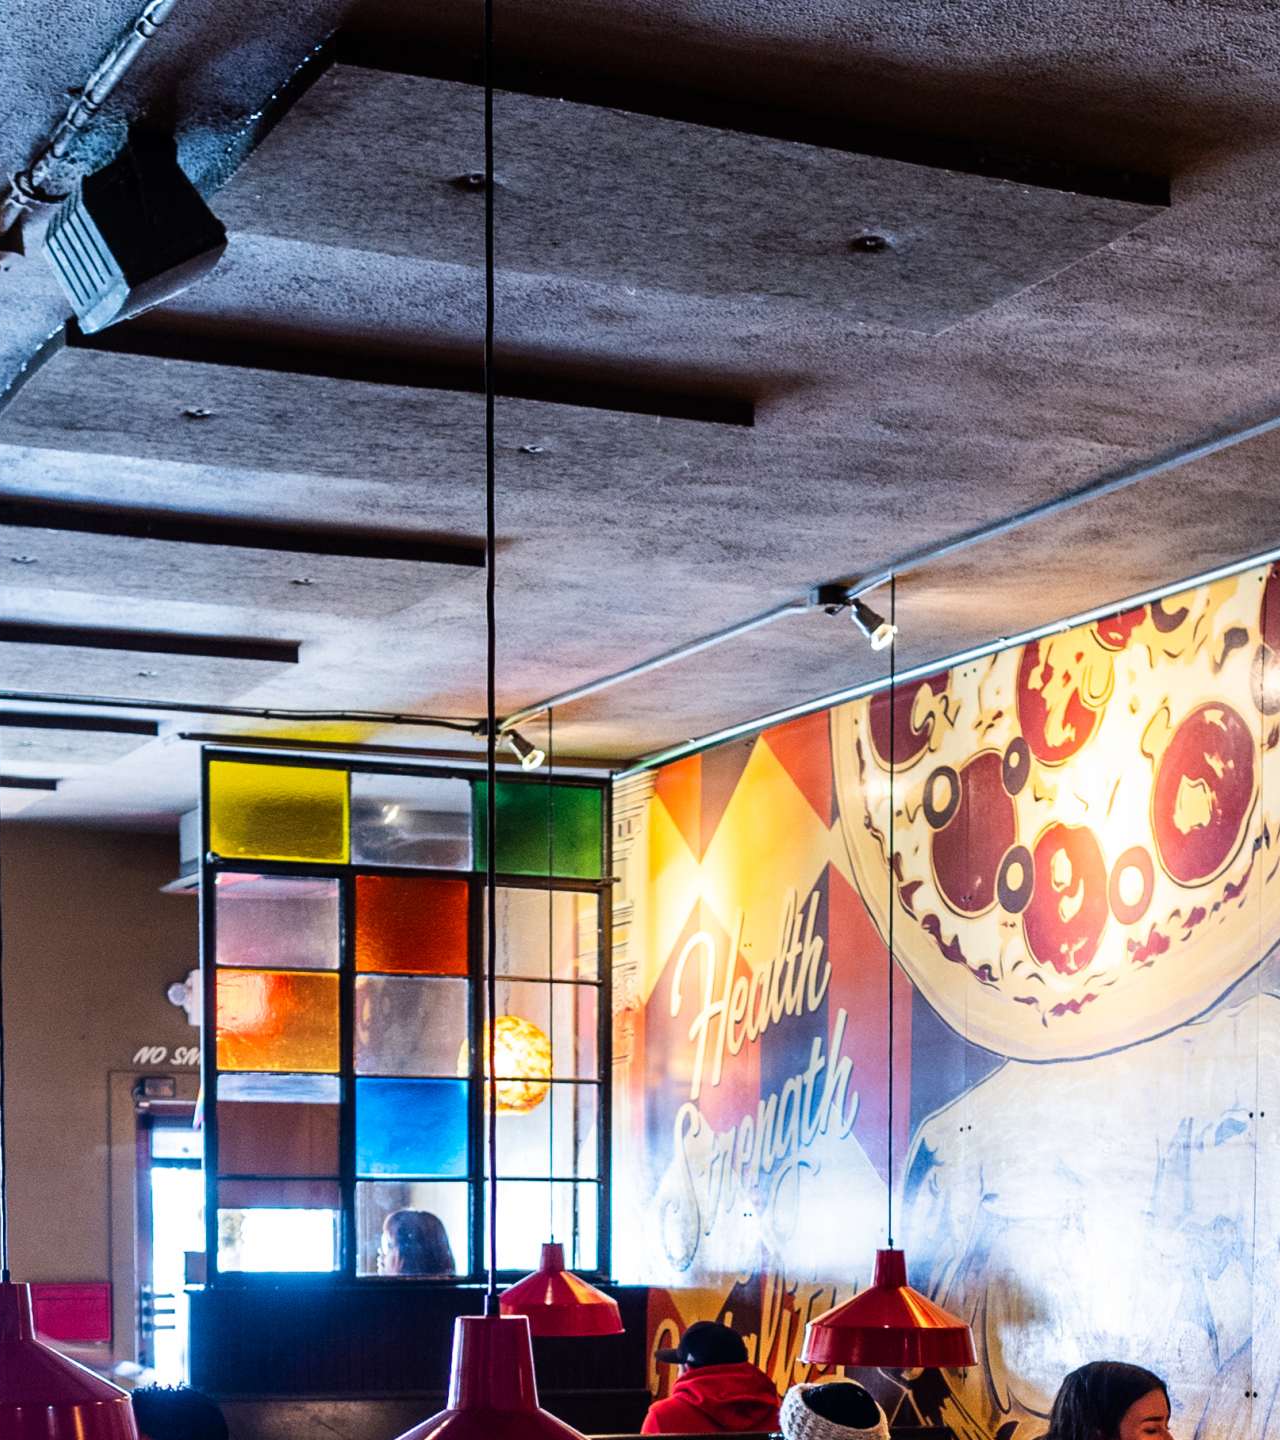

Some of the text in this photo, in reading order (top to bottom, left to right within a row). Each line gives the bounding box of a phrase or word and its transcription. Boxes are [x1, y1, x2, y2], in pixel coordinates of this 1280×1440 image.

[132, 1046, 168, 1065] NO
[670, 886, 832, 1100] Health
[658, 1006, 860, 1272] Strength
